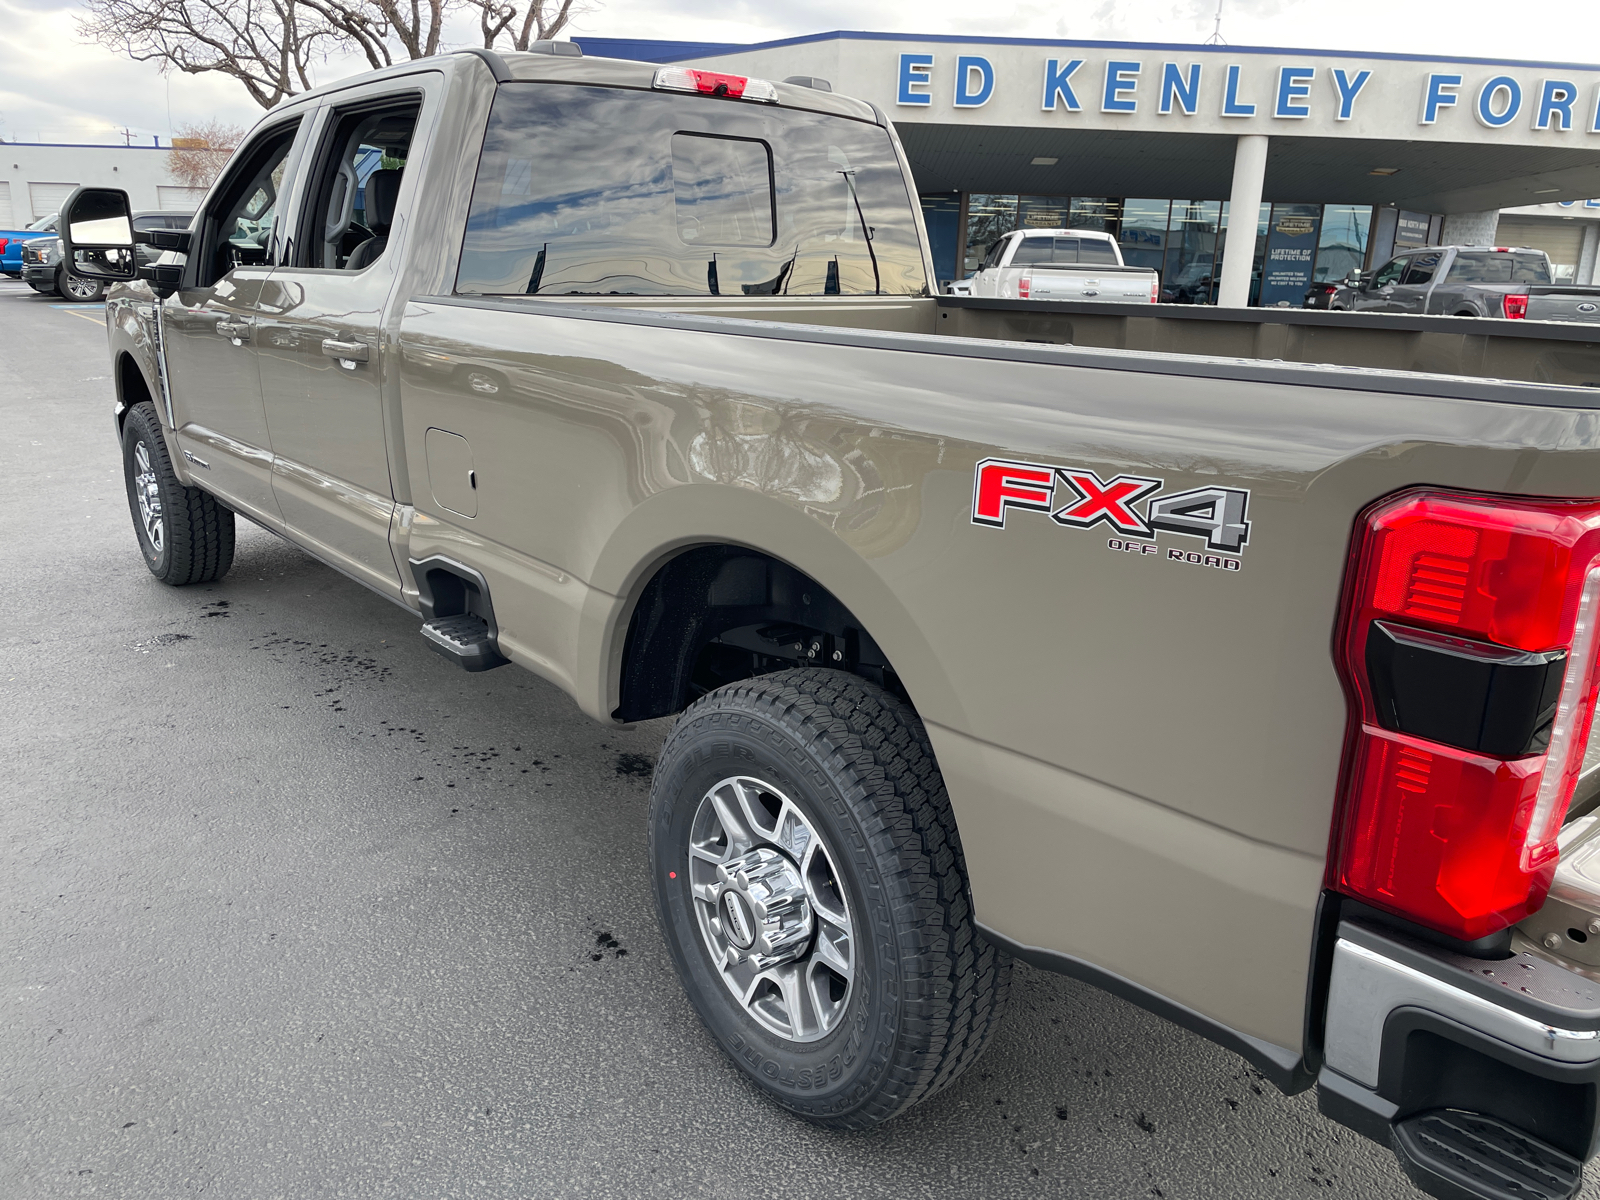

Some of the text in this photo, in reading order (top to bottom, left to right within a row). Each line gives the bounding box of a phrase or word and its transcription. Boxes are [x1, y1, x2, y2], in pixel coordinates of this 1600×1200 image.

[896, 53, 995, 109] ED
[1041, 58, 1373, 121] KENLEY
[971, 457, 1252, 556] FX4
[1107, 538, 1242, 572] OFF ROAD
[726, 968, 872, 1091] BRIDGESTONE
